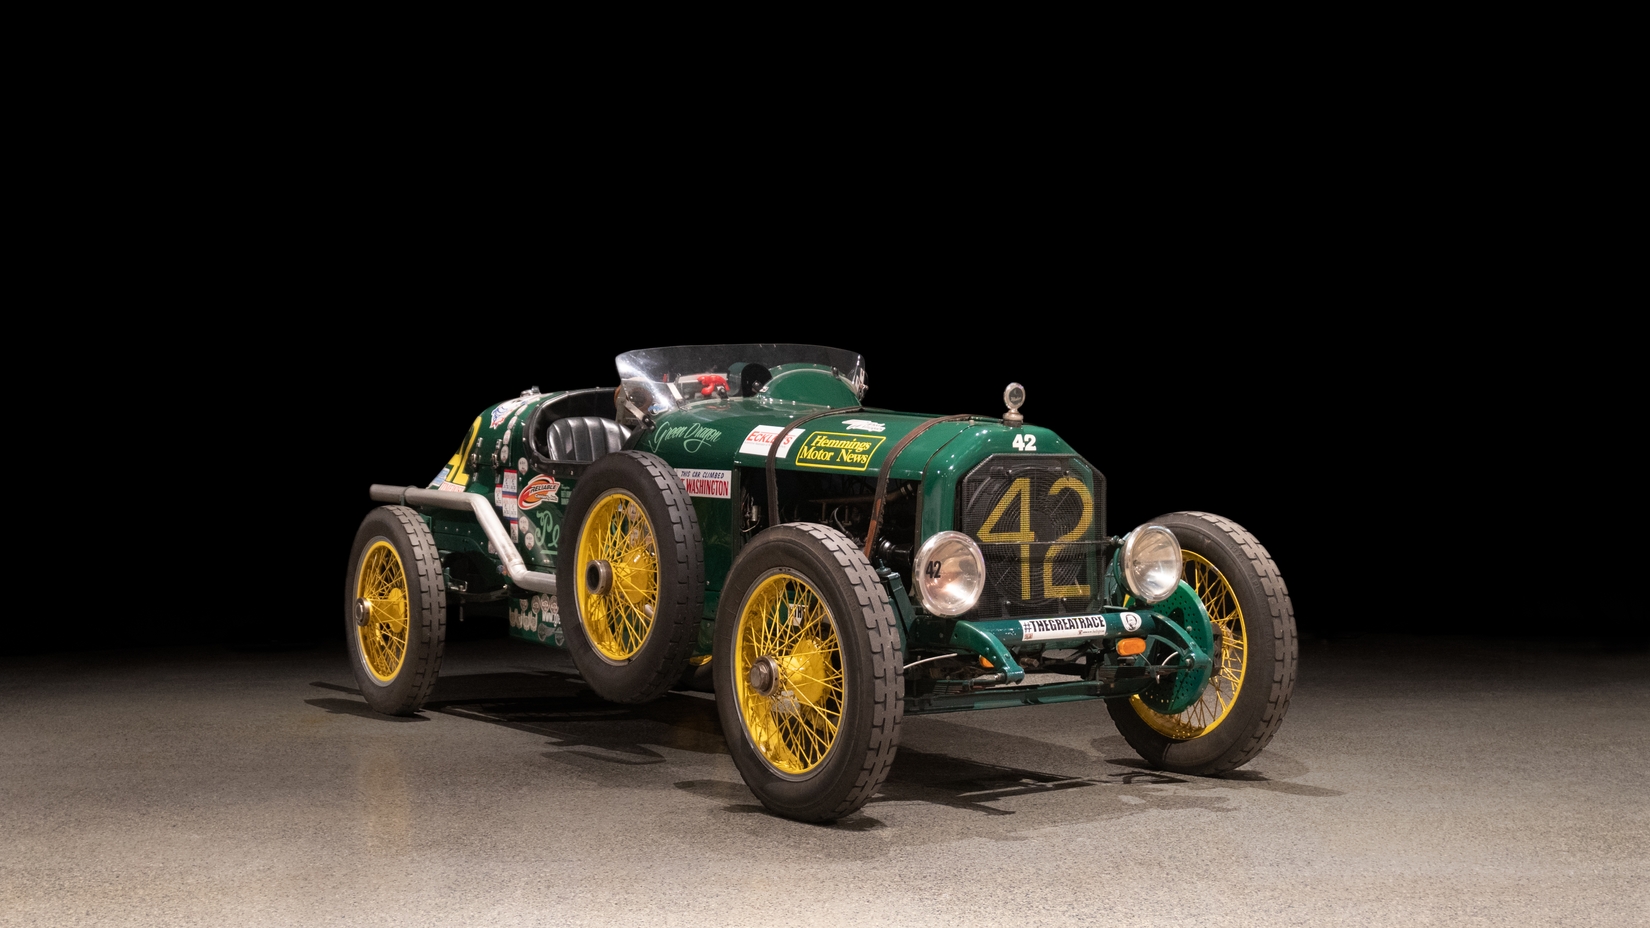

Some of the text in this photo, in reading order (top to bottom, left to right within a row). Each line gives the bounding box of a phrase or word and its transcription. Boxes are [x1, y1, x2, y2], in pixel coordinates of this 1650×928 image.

[648, 421, 722, 453] Green Dragon
[811, 435, 872, 452] Hemmings
[1012, 434, 1037, 451] 42
[800, 446, 869, 464] Motor News
[530, 484, 557, 494] RELIABLE
[686, 479, 729, 496] WASHINGTON
[976, 477, 1094, 600] 42
[925, 561, 942, 579] 42
[1023, 615, 1105, 633] #THEGREATRACE
